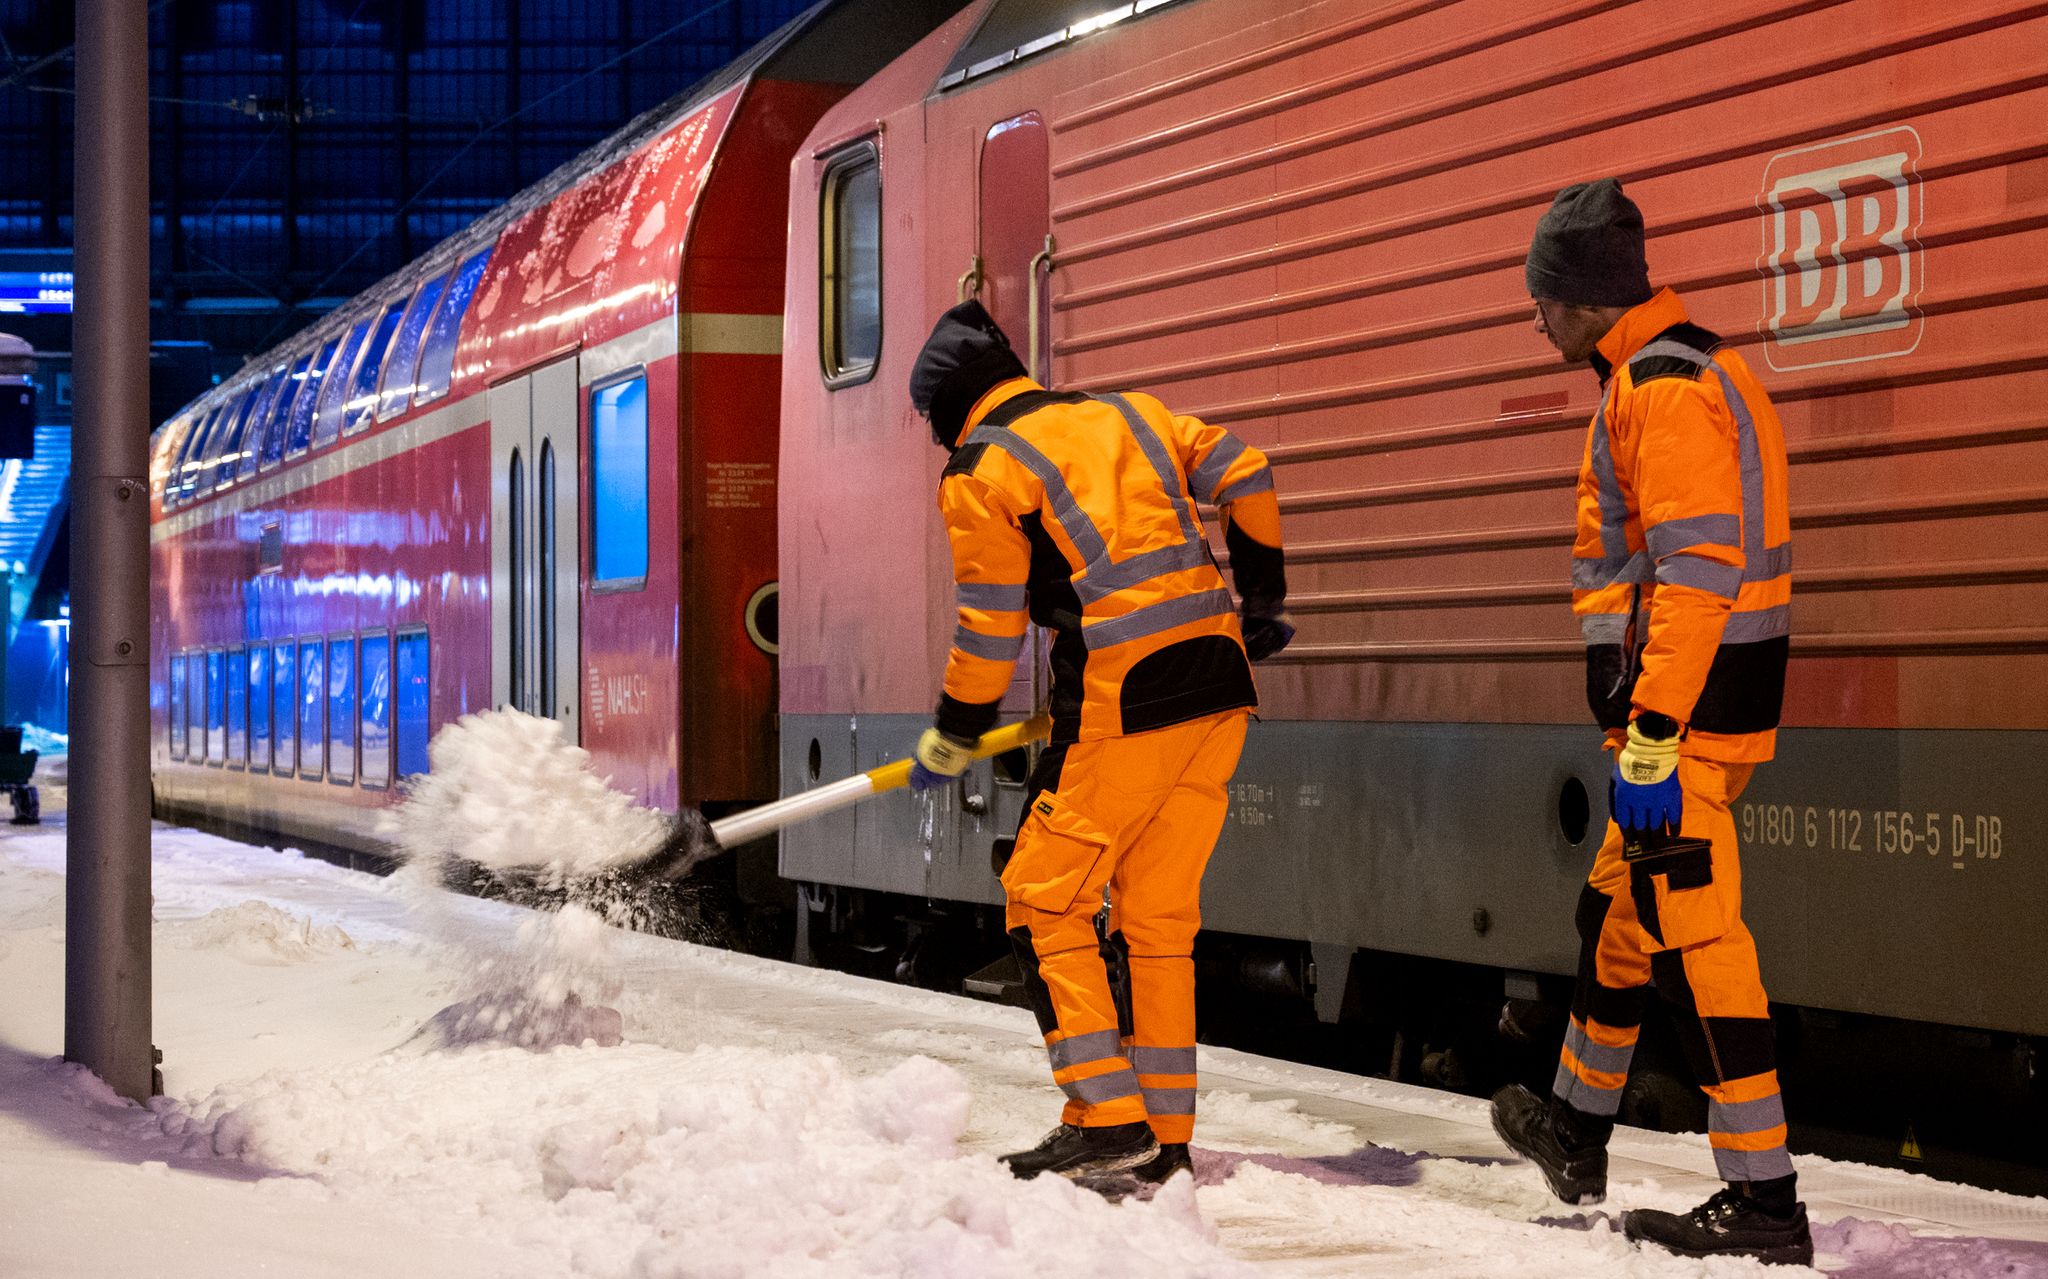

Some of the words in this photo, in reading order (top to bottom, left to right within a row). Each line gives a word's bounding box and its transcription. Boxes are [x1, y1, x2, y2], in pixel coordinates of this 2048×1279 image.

[1768, 152, 1910, 346] DB
[1742, 803, 1795, 847] 9180
[1804, 806, 1818, 848] 6
[1828, 808, 1862, 851] 112
[1873, 810, 1941, 857] 156-5
[1952, 813, 2001, 866] D-DB
